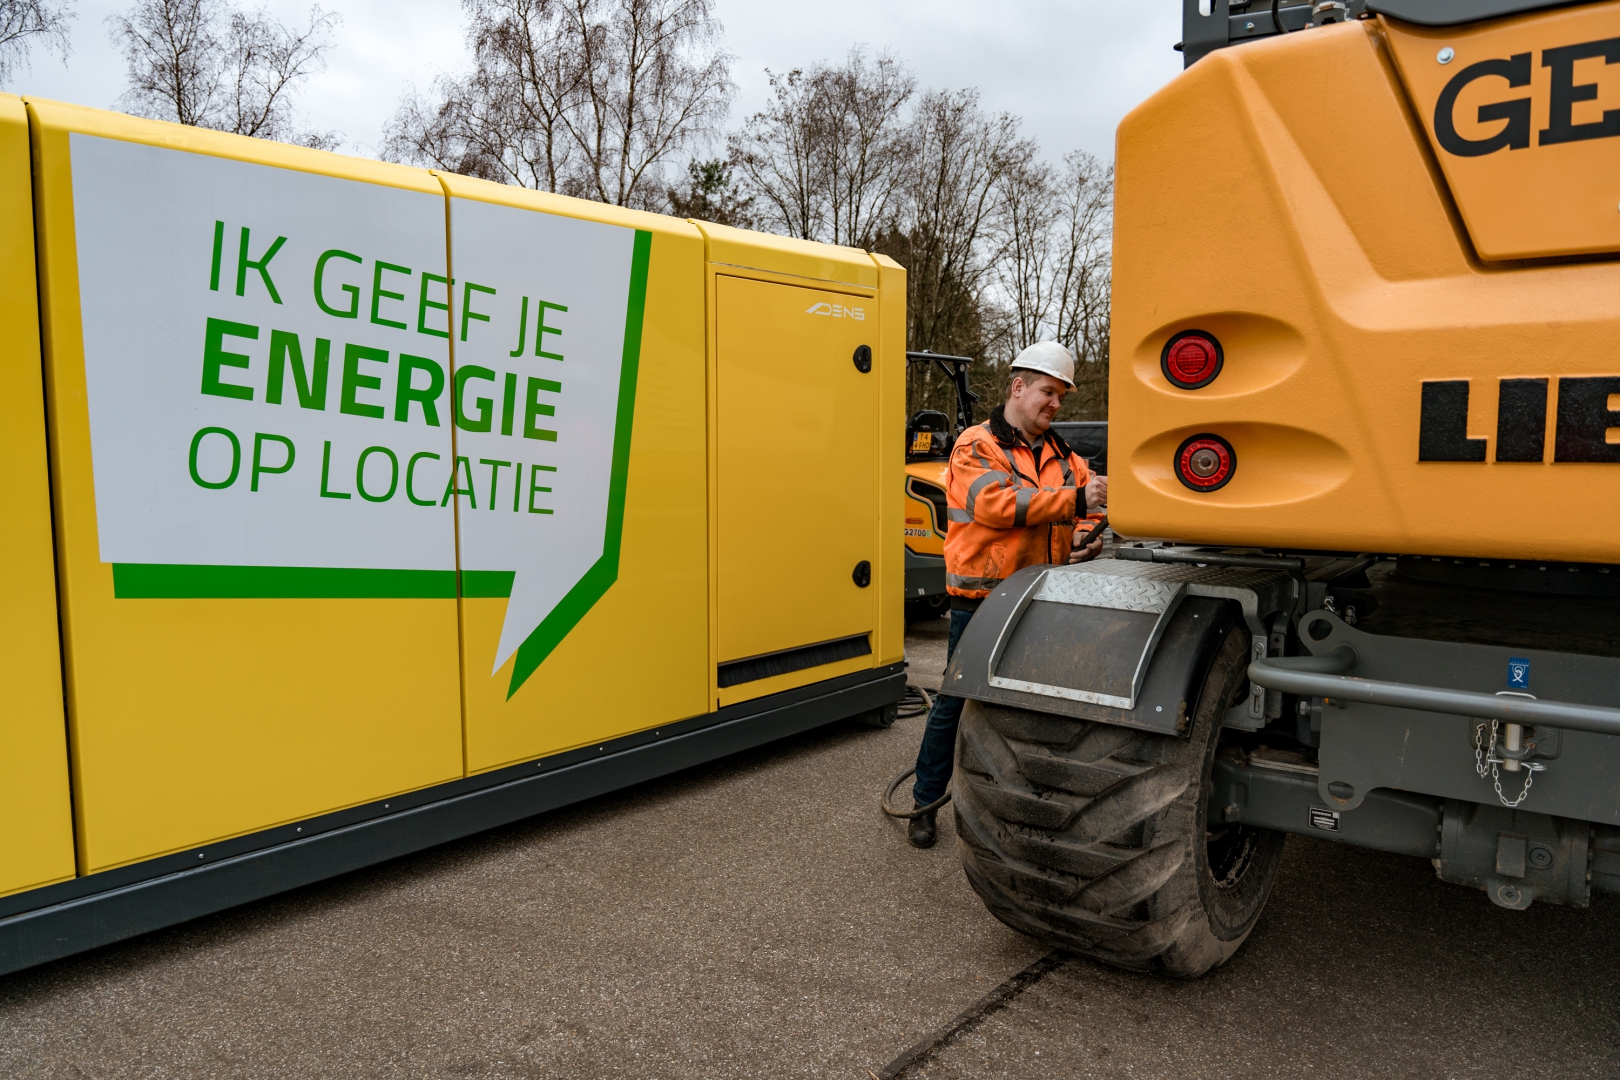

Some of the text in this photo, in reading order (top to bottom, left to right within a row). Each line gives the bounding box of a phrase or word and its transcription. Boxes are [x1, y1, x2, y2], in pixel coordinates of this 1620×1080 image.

[1433, 37, 1620, 158] GE
[208, 219, 569, 362] IK GEEF JE
[199, 316, 563, 443] ENERGIE
[187, 425, 558, 515] OP LOCATIE
